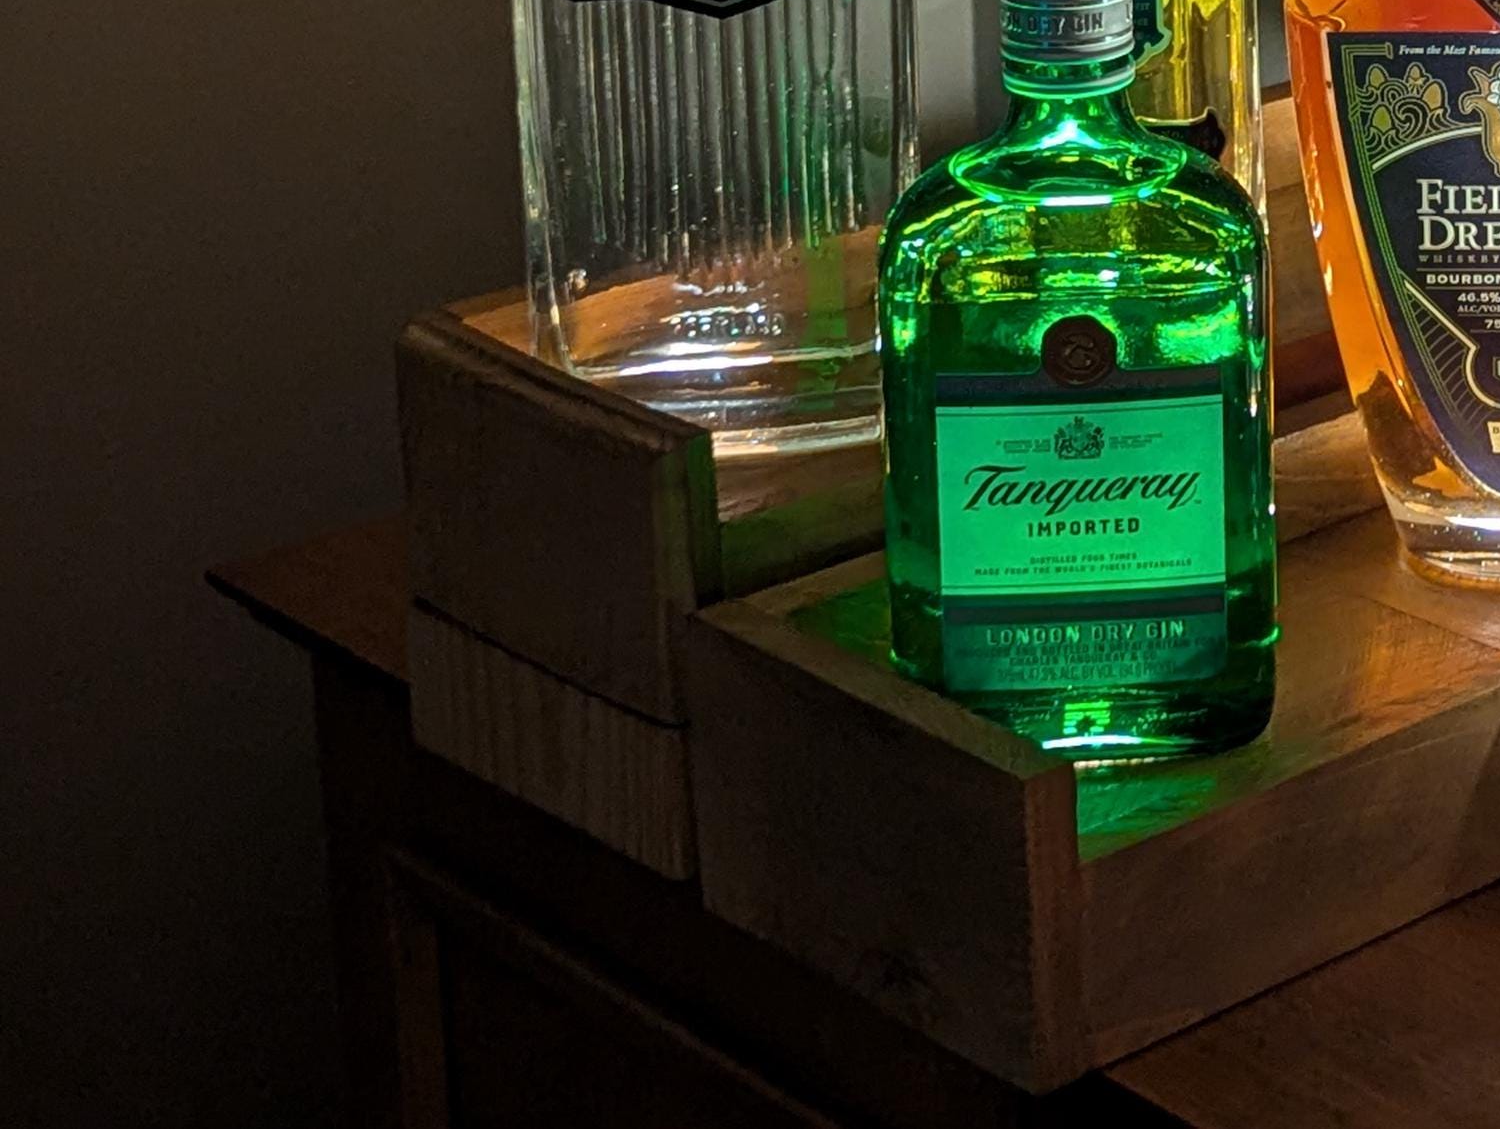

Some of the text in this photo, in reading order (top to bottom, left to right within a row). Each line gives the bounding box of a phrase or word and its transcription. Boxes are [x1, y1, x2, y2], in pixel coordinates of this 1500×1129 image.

[1074, 12, 1105, 34] GIN
[1399, 45, 1424, 55] From
[1426, 45, 1441, 55] the
[1443, 45, 1466, 55] Most
[963, 465, 1200, 517] Tanqueray
[1028, 517, 1140, 538] IMPORTED
[1030, 554, 1077, 565] DISTILLED
[1109, 552, 1137, 562] TIMES
[986, 620, 1184, 646] LONDON DRY GIN
